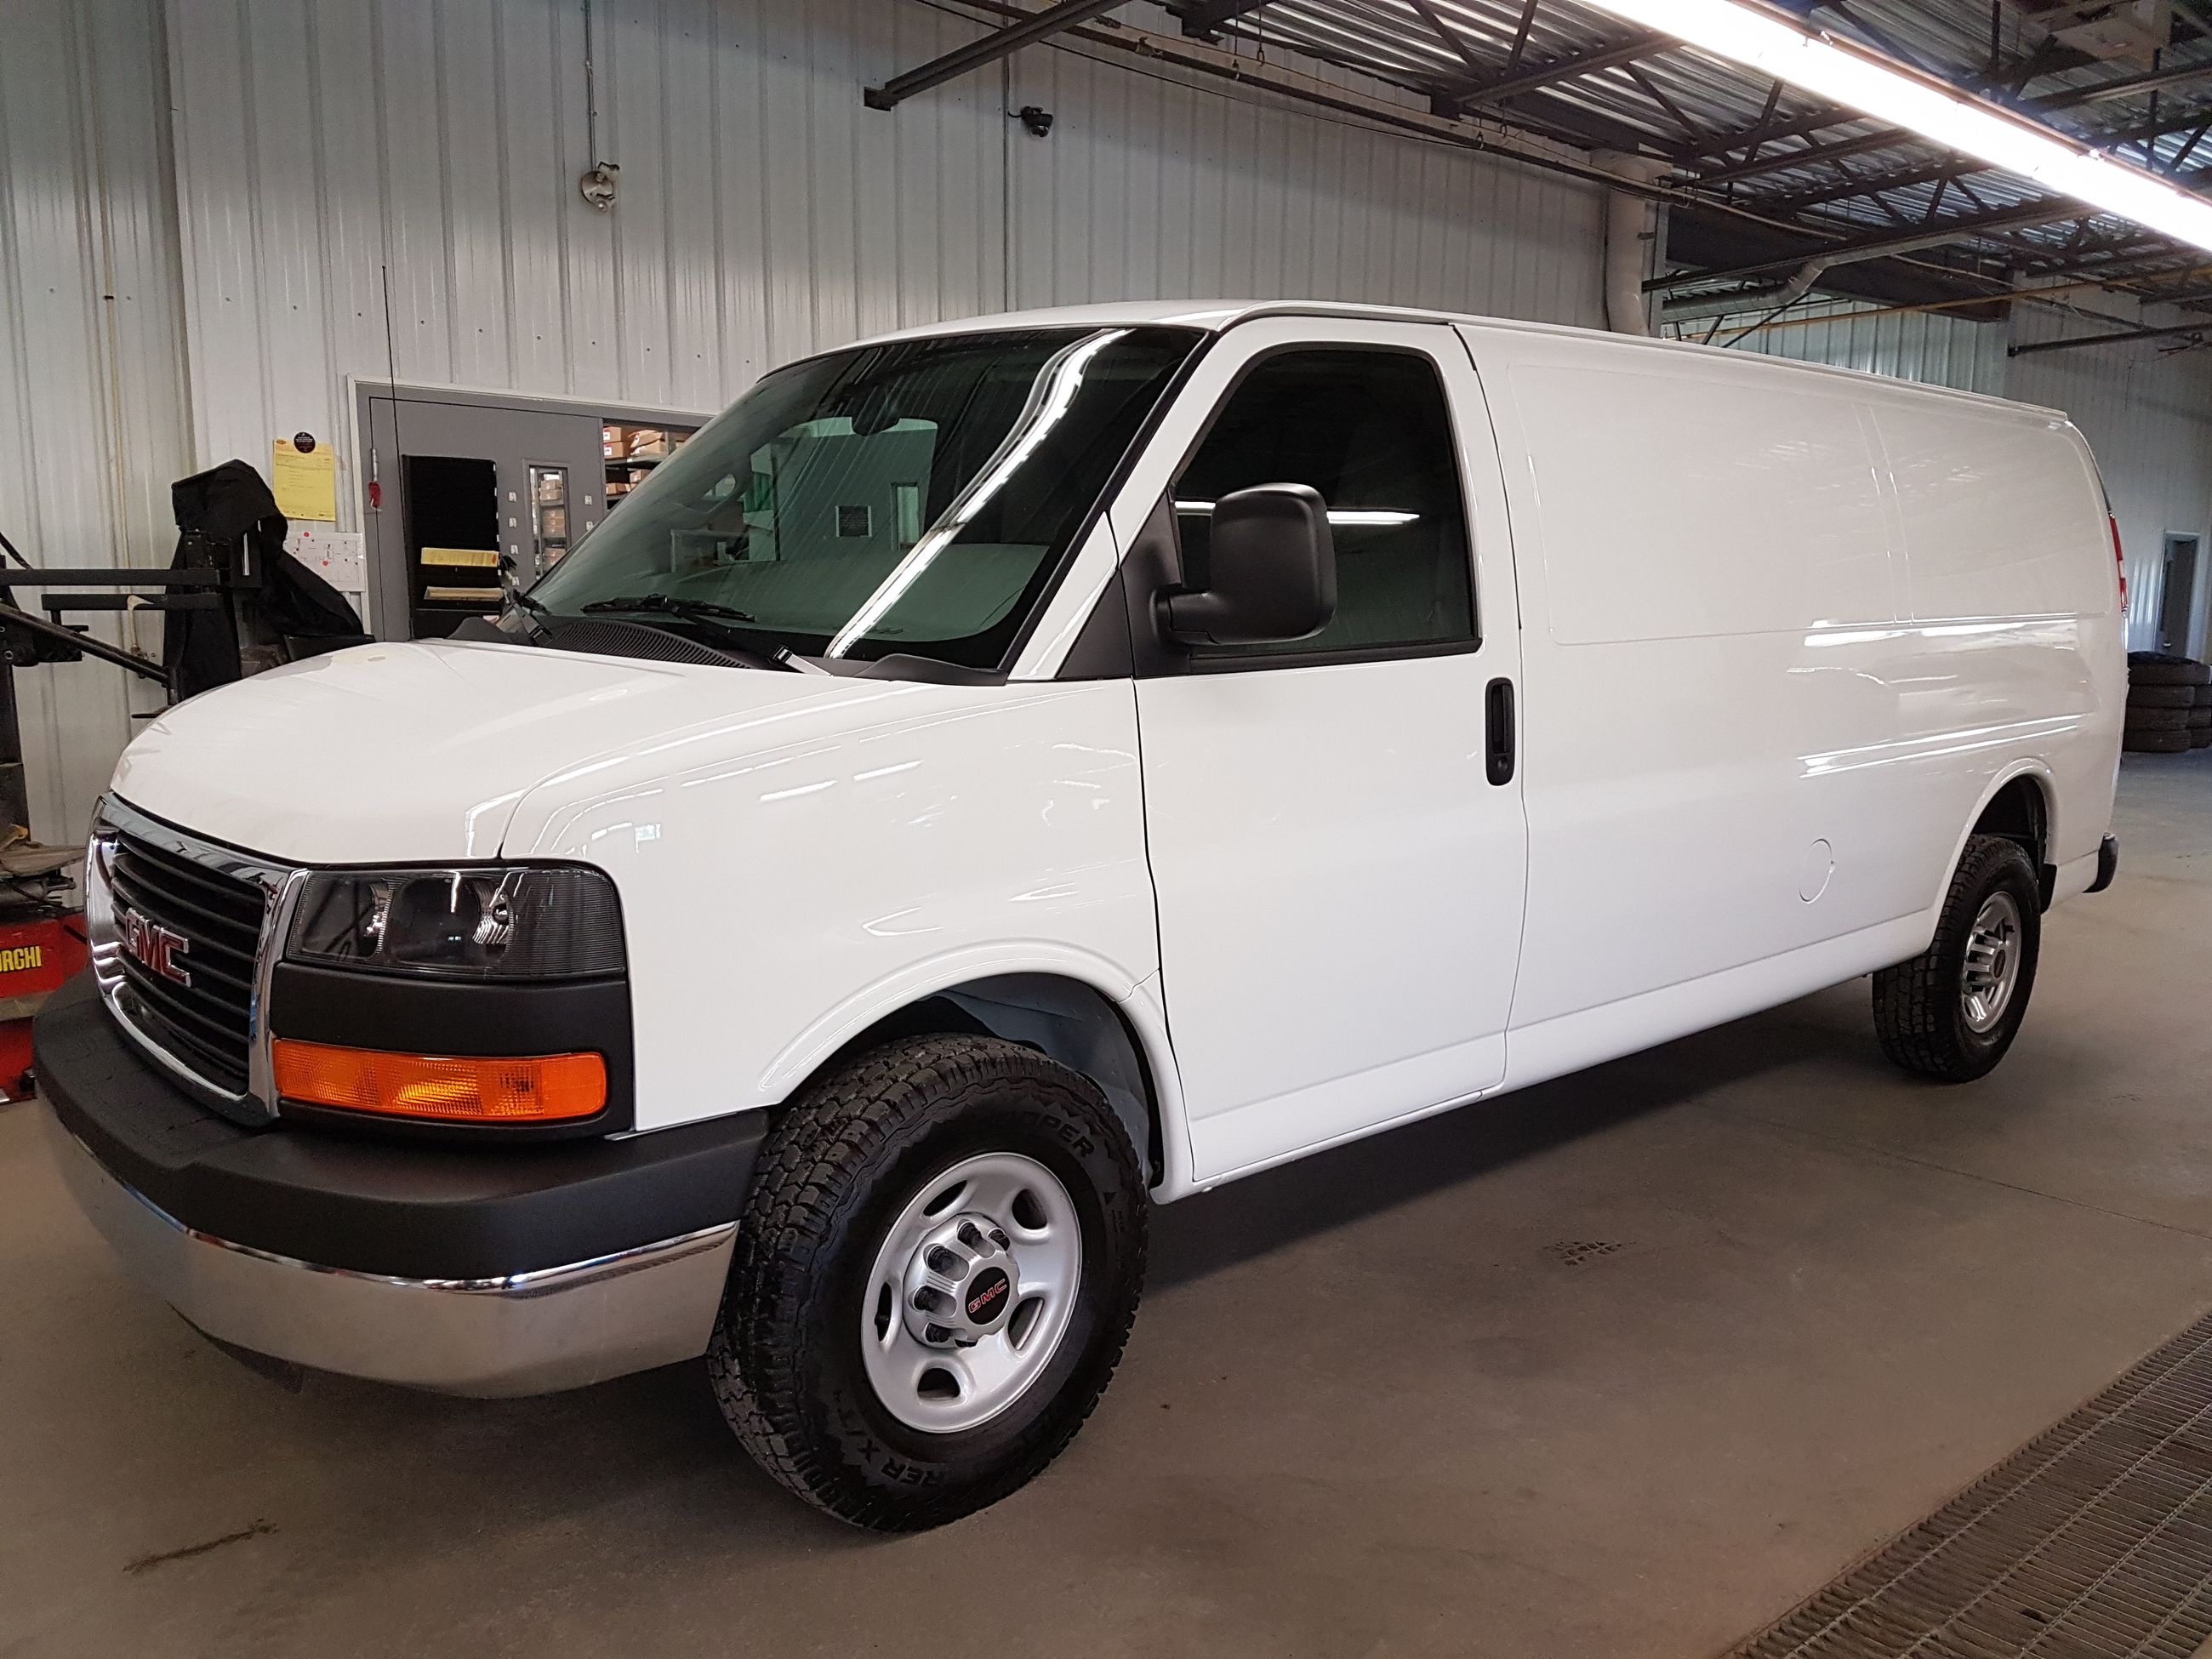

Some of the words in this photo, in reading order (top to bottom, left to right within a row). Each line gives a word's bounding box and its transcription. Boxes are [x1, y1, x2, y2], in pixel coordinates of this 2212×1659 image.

[0, 945, 43, 972] RGHI
[126, 908, 191, 987] GMC
[968, 1278, 1007, 1313] GMC
